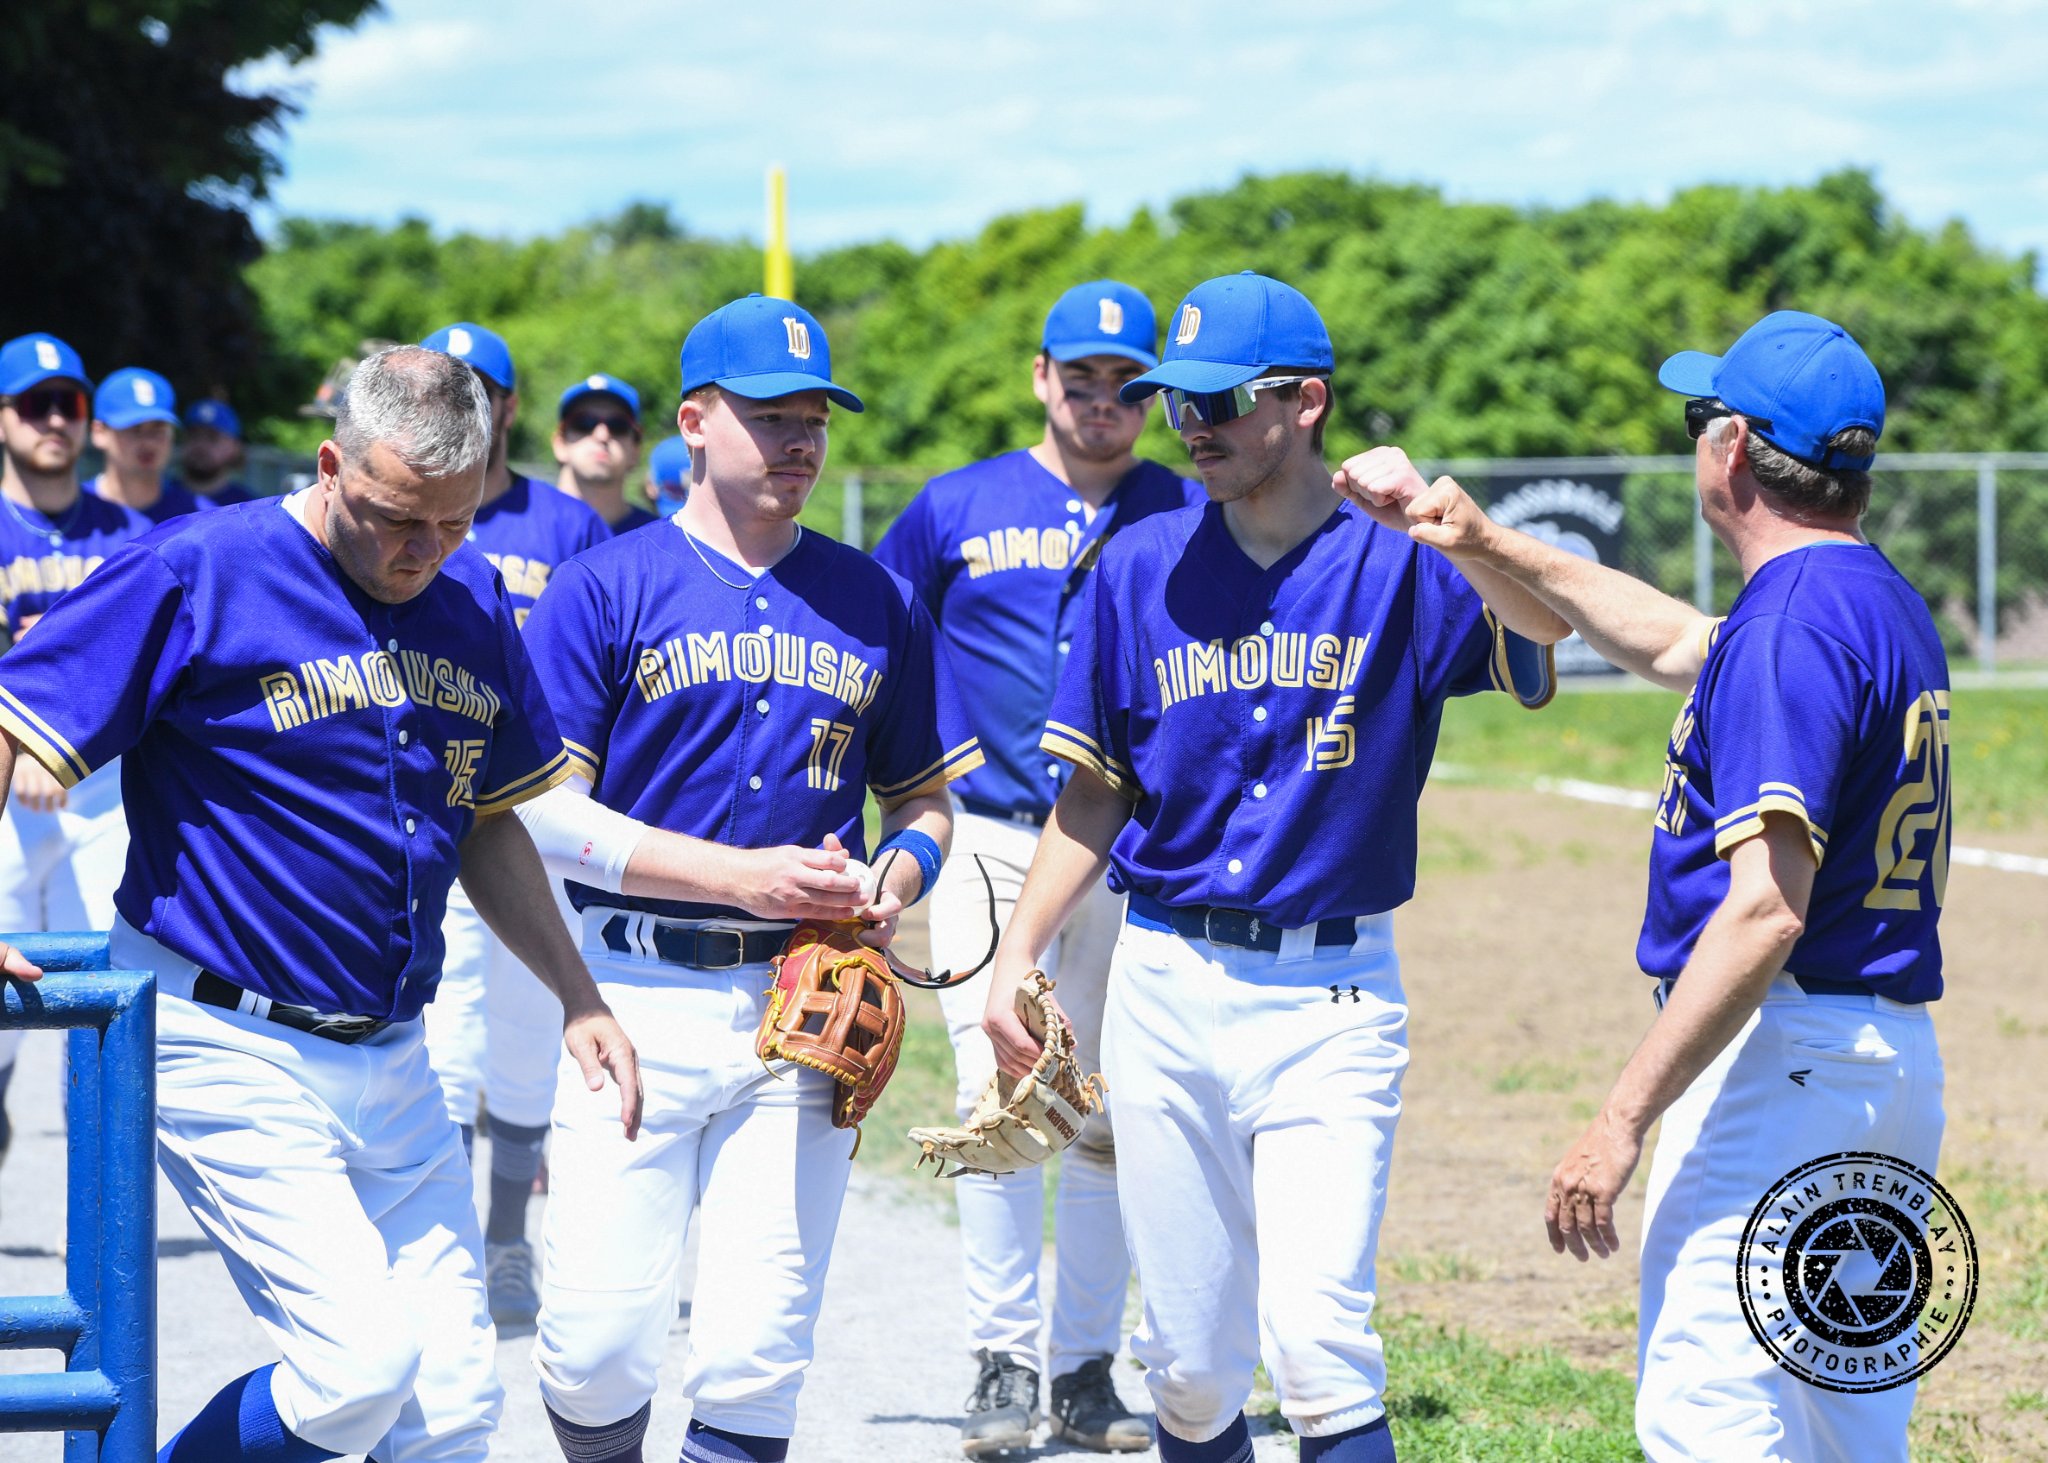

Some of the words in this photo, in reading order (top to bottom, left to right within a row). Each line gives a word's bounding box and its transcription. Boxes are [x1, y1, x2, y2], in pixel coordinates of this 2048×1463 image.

[259, 649, 500, 733] RIMOUSKI
[636, 631, 883, 718] RIMOUSKI
[808, 718, 855, 792] 17
[1302, 695, 1355, 774] 15
[1044, 1106, 1079, 1141] marucci
